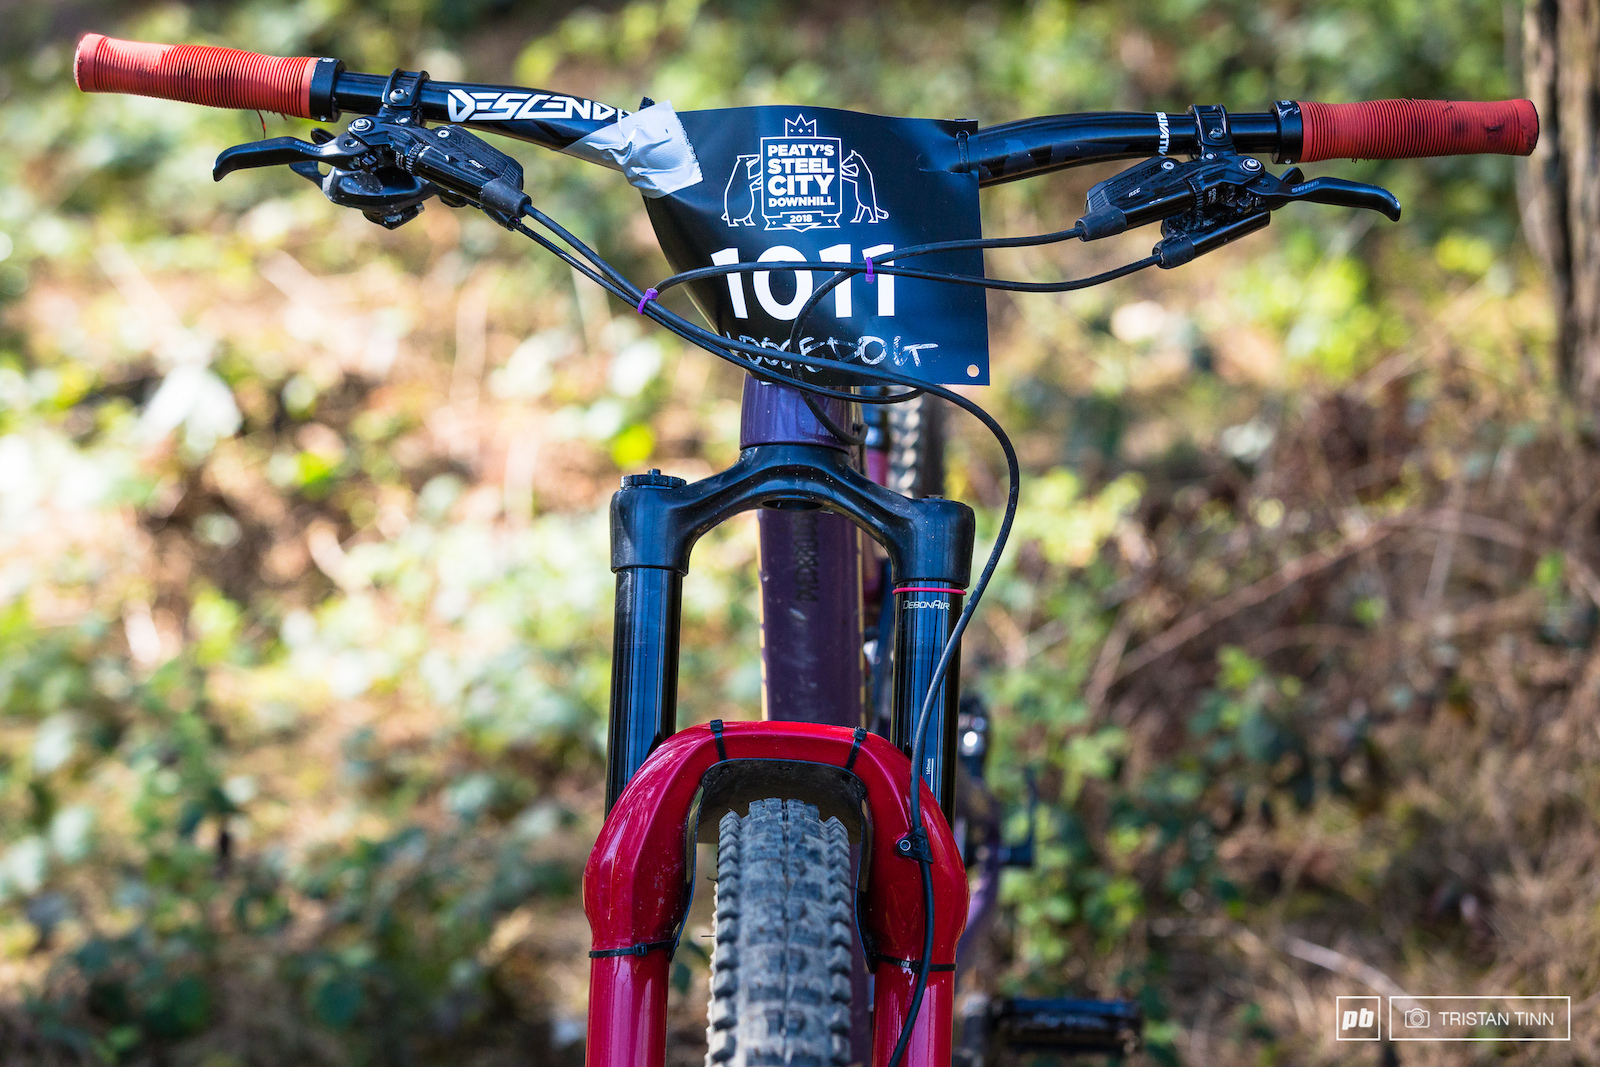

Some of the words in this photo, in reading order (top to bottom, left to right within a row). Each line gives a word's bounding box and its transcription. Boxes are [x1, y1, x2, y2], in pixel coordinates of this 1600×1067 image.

[767, 144, 835, 157] PEATY'S
[767, 157, 835, 174] STEEL
[767, 174, 835, 196] CITY
[768, 196, 835, 207] DOWNHILL
[789, 214, 813, 223] 2018
[710, 243, 895, 321] 1011
